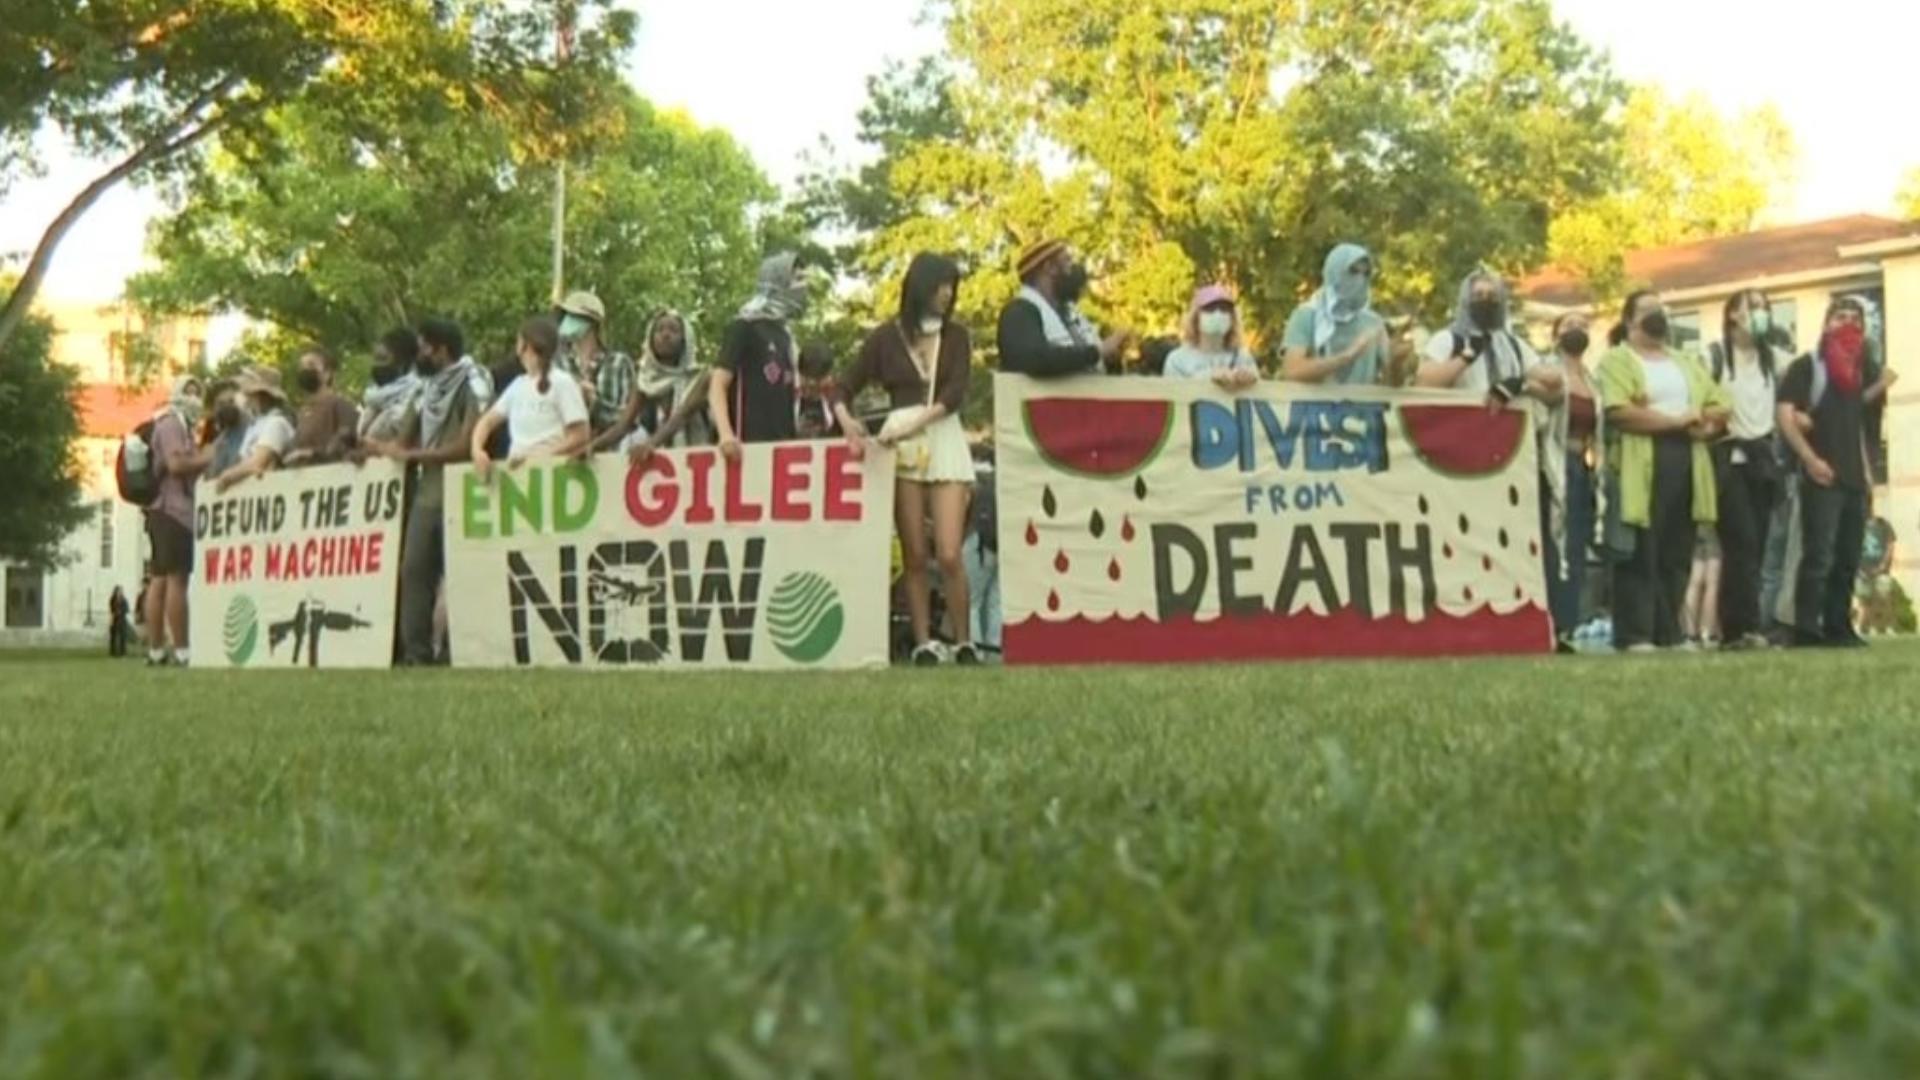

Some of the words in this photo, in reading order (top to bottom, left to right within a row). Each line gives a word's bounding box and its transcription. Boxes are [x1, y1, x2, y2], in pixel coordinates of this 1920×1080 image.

[1190, 398, 1391, 473] DIVEST
[196, 494, 286, 541] DEFUND
[300, 485, 352, 530] THE
[364, 478, 401, 522] US
[463, 463, 599, 539] END
[624, 445, 866, 528] GILEE
[1245, 483, 1344, 515] FROM
[205, 545, 253, 586] WAR
[266, 532, 385, 582] MACHINE
[1151, 521, 1437, 623] DEATH
[506, 537, 767, 665] NOW
